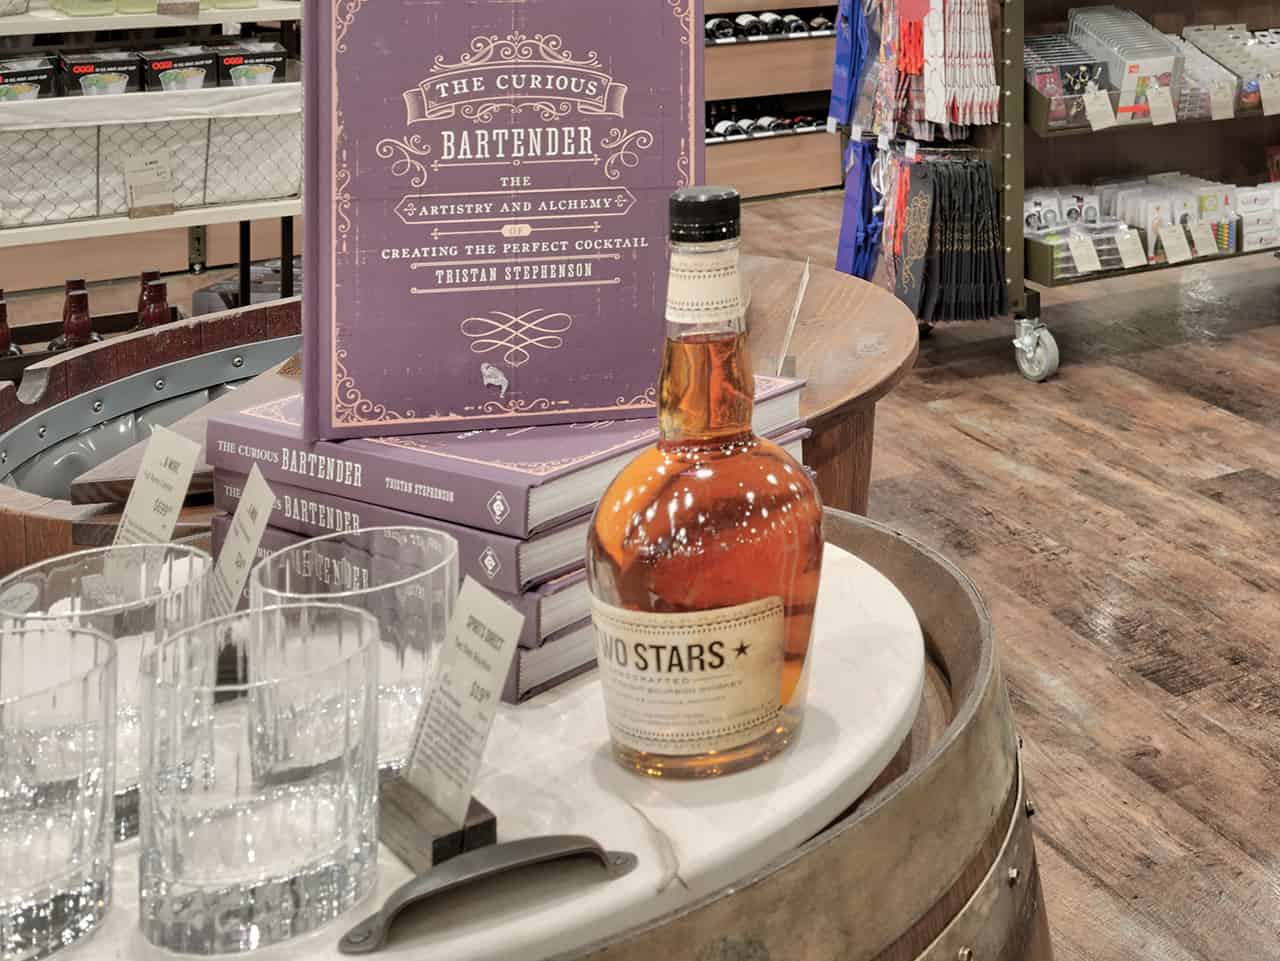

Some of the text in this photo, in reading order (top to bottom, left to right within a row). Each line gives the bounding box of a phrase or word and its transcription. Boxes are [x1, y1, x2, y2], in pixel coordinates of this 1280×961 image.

[435, 74, 600, 99] THE CURIOUS
[440, 125, 594, 161] BARTENDER
[500, 176, 533, 188] THE
[418, 197, 613, 217] ARTISTRY AND ALCHEMY
[381, 236, 649, 260] CREATING THE PERFECT COCKTAIL
[435, 263, 593, 286] TRISTAN STEPHENSON
[218, 440, 363, 488] THE CURIOUS BARTENDER
[385, 477, 455, 503] TRISTAN STEPHENSON
[284, 495, 361, 537] BARTENDER
[597, 630, 725, 673] WO STARS
